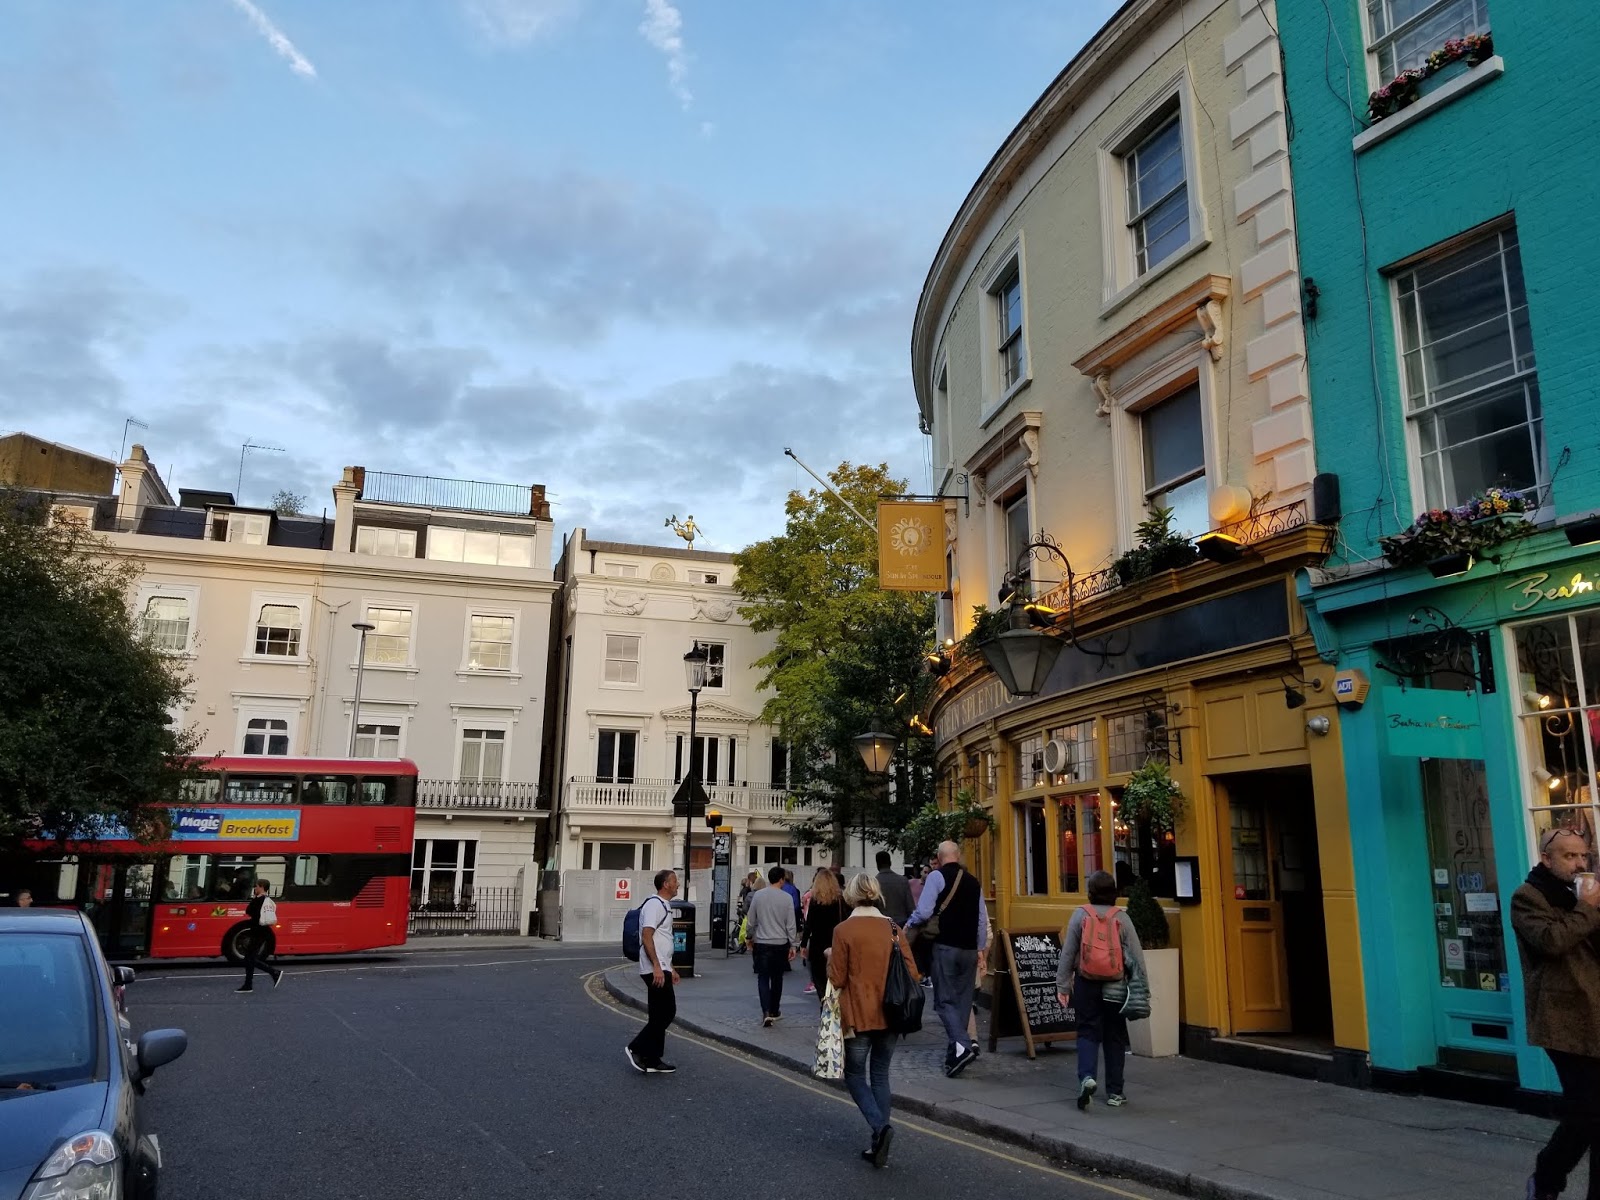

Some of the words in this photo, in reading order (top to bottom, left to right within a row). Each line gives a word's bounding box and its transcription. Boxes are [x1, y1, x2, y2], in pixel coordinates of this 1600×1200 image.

[1338, 680, 1352, 691] ADT
[180, 815, 221, 832] Magic
[225, 824, 290, 835] Breakfast
